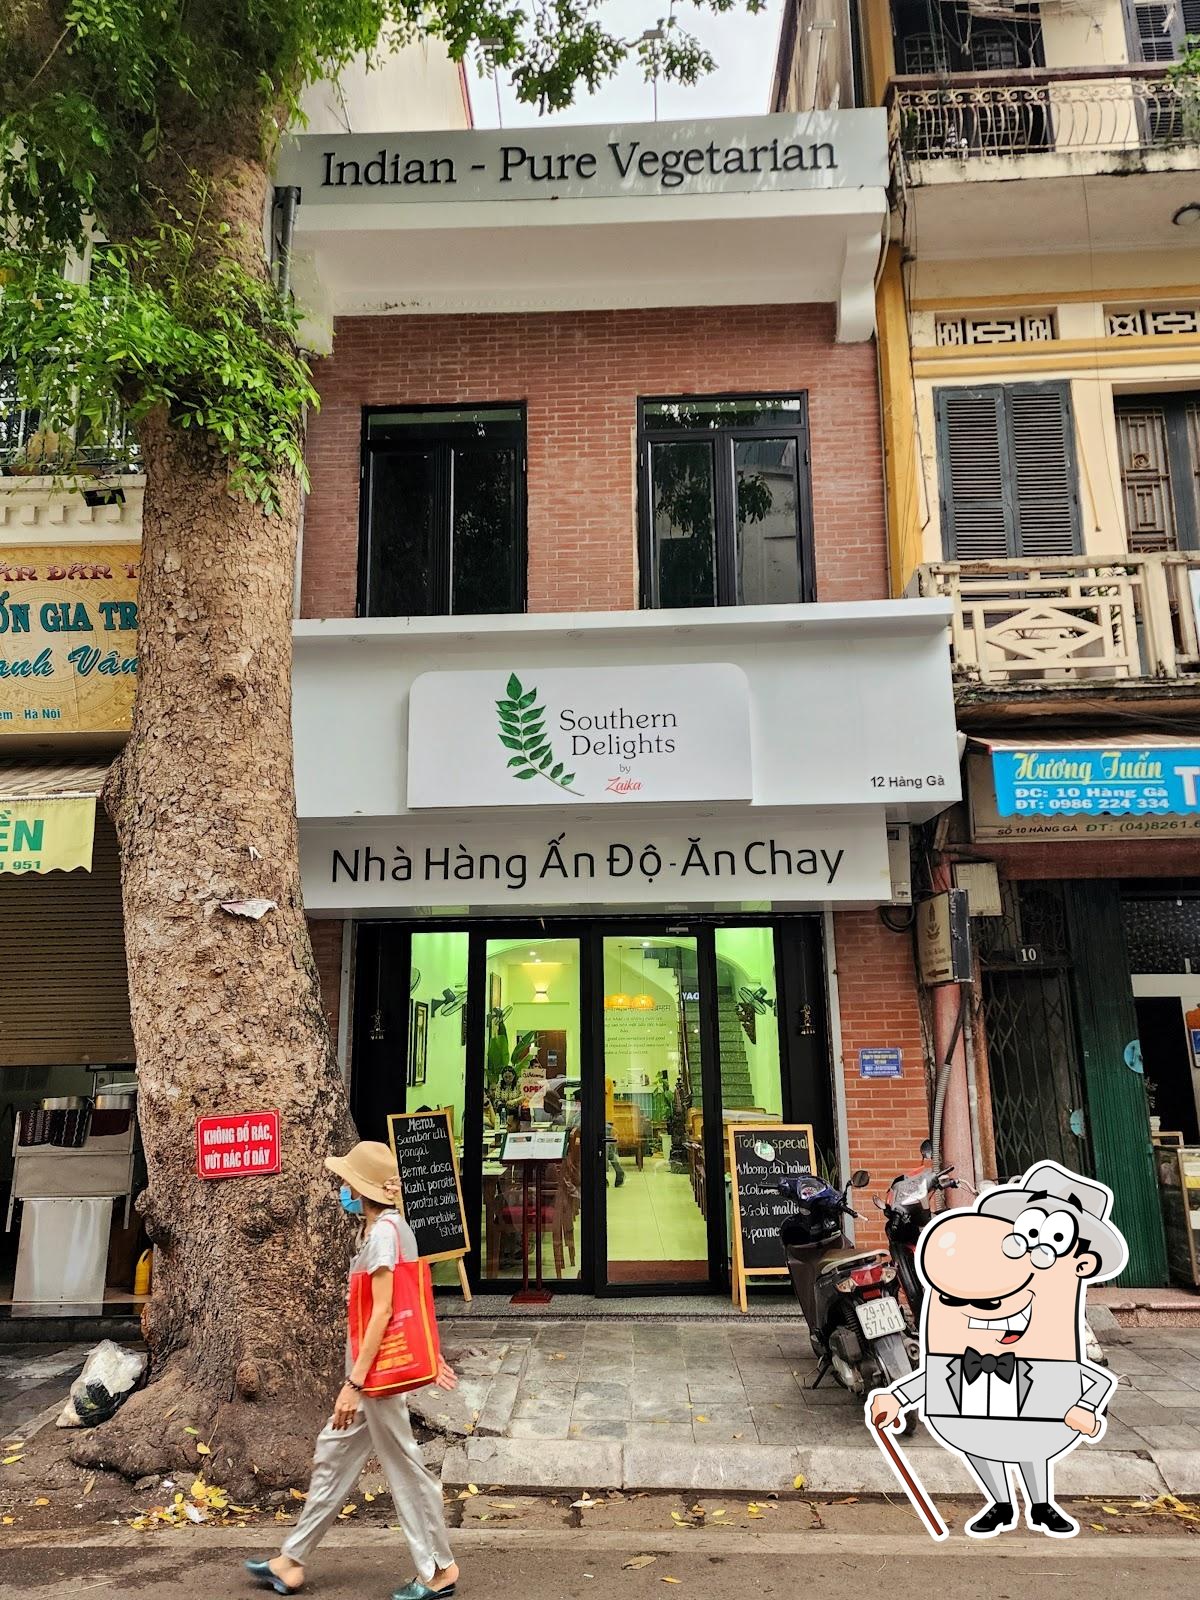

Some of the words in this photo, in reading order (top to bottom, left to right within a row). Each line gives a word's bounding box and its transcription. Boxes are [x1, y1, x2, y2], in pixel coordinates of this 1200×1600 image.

[321, 149, 457, 186] Indian
[499, 146, 598, 182] Pure
[607, 138, 839, 188] Vegetarian
[39, 601, 94, 633] GIA
[24, 708, 39, 720] Hà
[42, 707, 61, 721] Nội
[559, 707, 679, 732] Southern
[571, 732, 676, 760] Delights
[619, 763, 631, 774] by
[604, 776, 643, 795] Zaika
[870, 776, 886, 788] 12
[888, 775, 923, 789] Hàng
[926, 774, 945, 787] Gà
[1015, 787, 1049, 799] ĐC:
[1056, 787, 1081, 799] 10
[1086, 786, 1137, 799] Hàng
[1142, 786, 1169, 798] Gà
[1015, 799, 1045, 810] ĐT:
[1049, 798, 1094, 810] 0986
[1099, 798, 1132, 809] 224
[1136, 798, 1170, 809] 334
[1014, 826, 1027, 835] 10
[1029, 824, 1060, 834] HÀNG
[1062, 822, 1078, 833] GÀ
[1085, 822, 1114, 833] ĐT:
[12, 860, 41, 870] 951
[332, 845, 412, 882] Nhà
[424, 843, 527, 889] Hàng
[539, 832, 595, 878] Ấn
[606, 844, 662, 883] Độ
[680, 837, 736, 876] Ăn
[744, 839, 845, 884] Chay
[1020, 947, 1037, 962] 10
[407, 1117, 436, 1132] Menu
[203, 1125, 235, 1146] KHÔNG
[251, 1121, 273, 1142] RÁC,
[396, 1132, 431, 1145] Sambar
[771, 1135, 809, 1156] special
[222, 1149, 242, 1169] RÁC
[243, 1144, 251, 1167] Ở
[251, 1146, 271, 1166] ĐÂY
[430, 1161, 453, 1174] dosa
[863, 1301, 893, 1320] 29-P1
